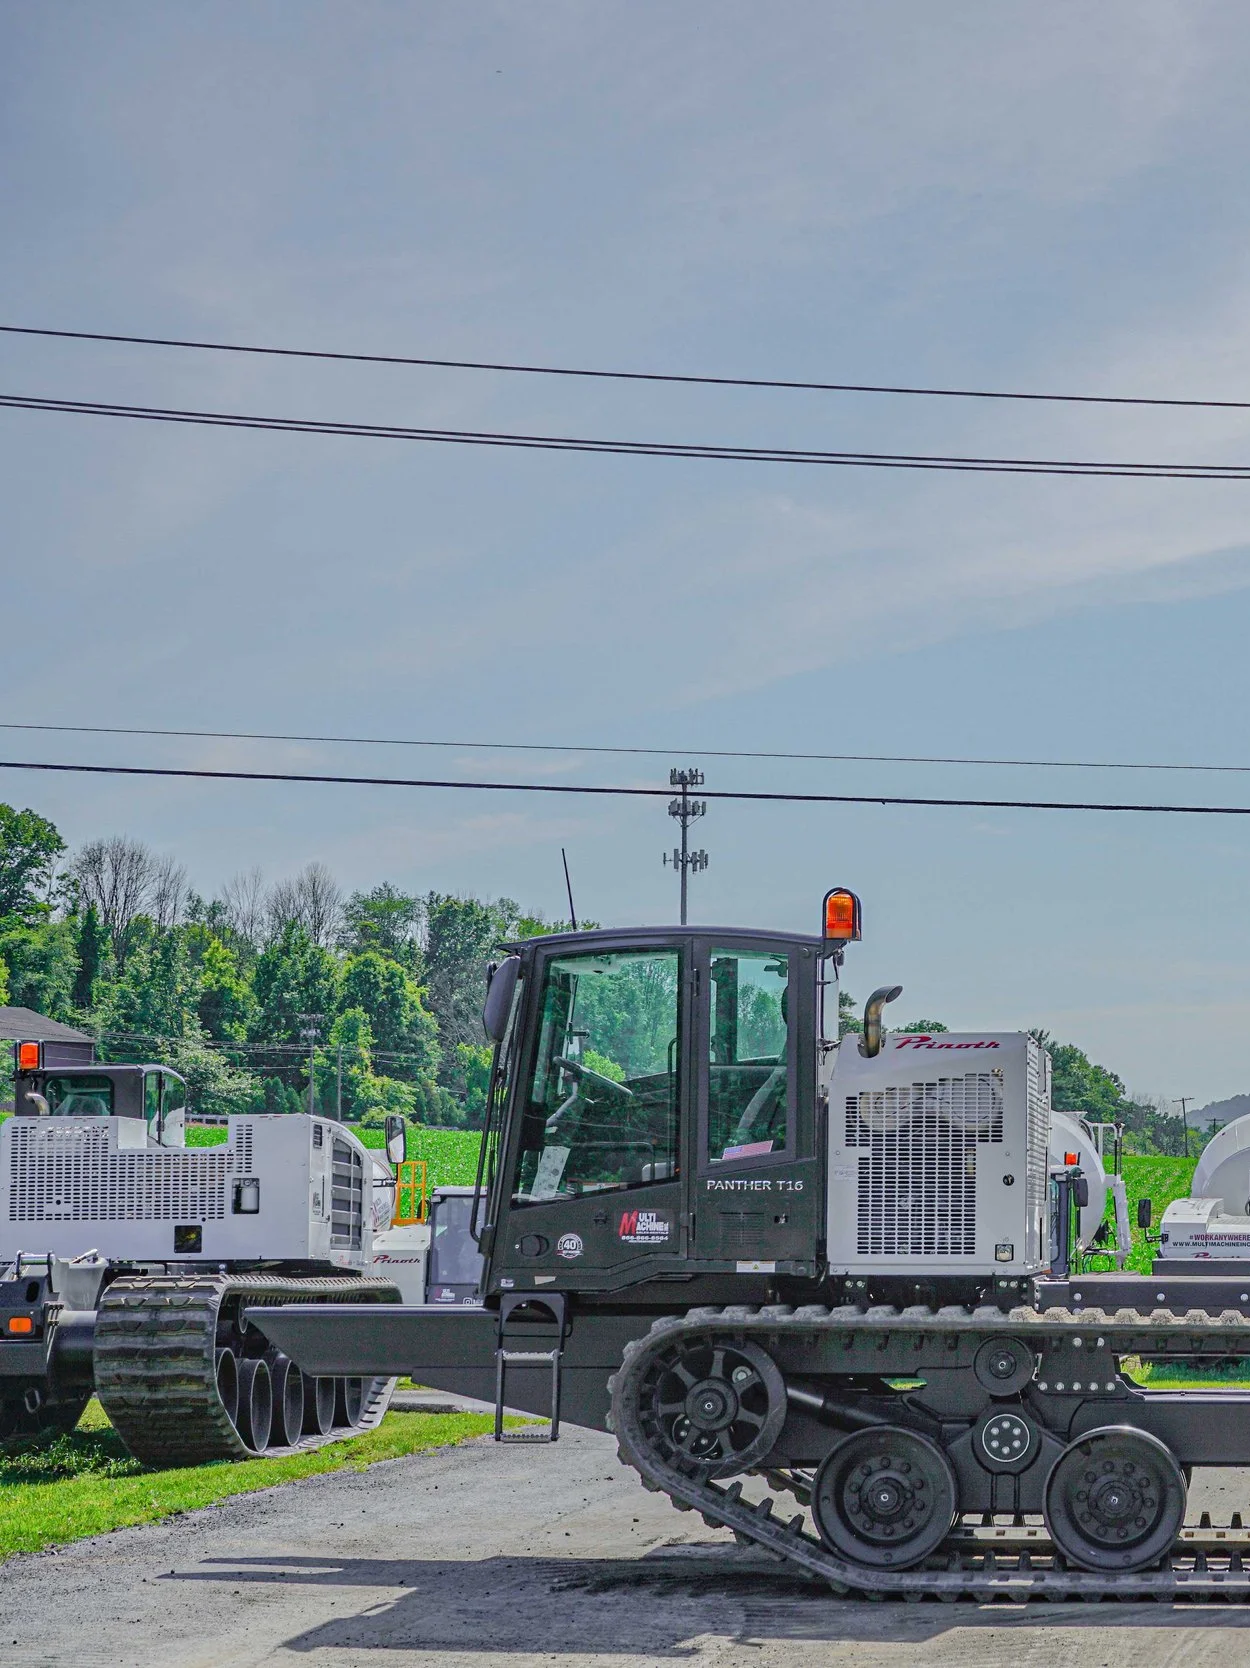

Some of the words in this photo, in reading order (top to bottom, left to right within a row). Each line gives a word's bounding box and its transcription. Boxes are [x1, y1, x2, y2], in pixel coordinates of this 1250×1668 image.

[893, 1035, 1000, 1049] Prinoth
[706, 1180, 772, 1191] PANTHER
[776, 1180, 804, 1191] T16
[619, 1208, 638, 1237] M
[638, 1212, 656, 1223] ULTI
[636, 1221, 664, 1231] ACHINE
[563, 1240, 578, 1250] 40
